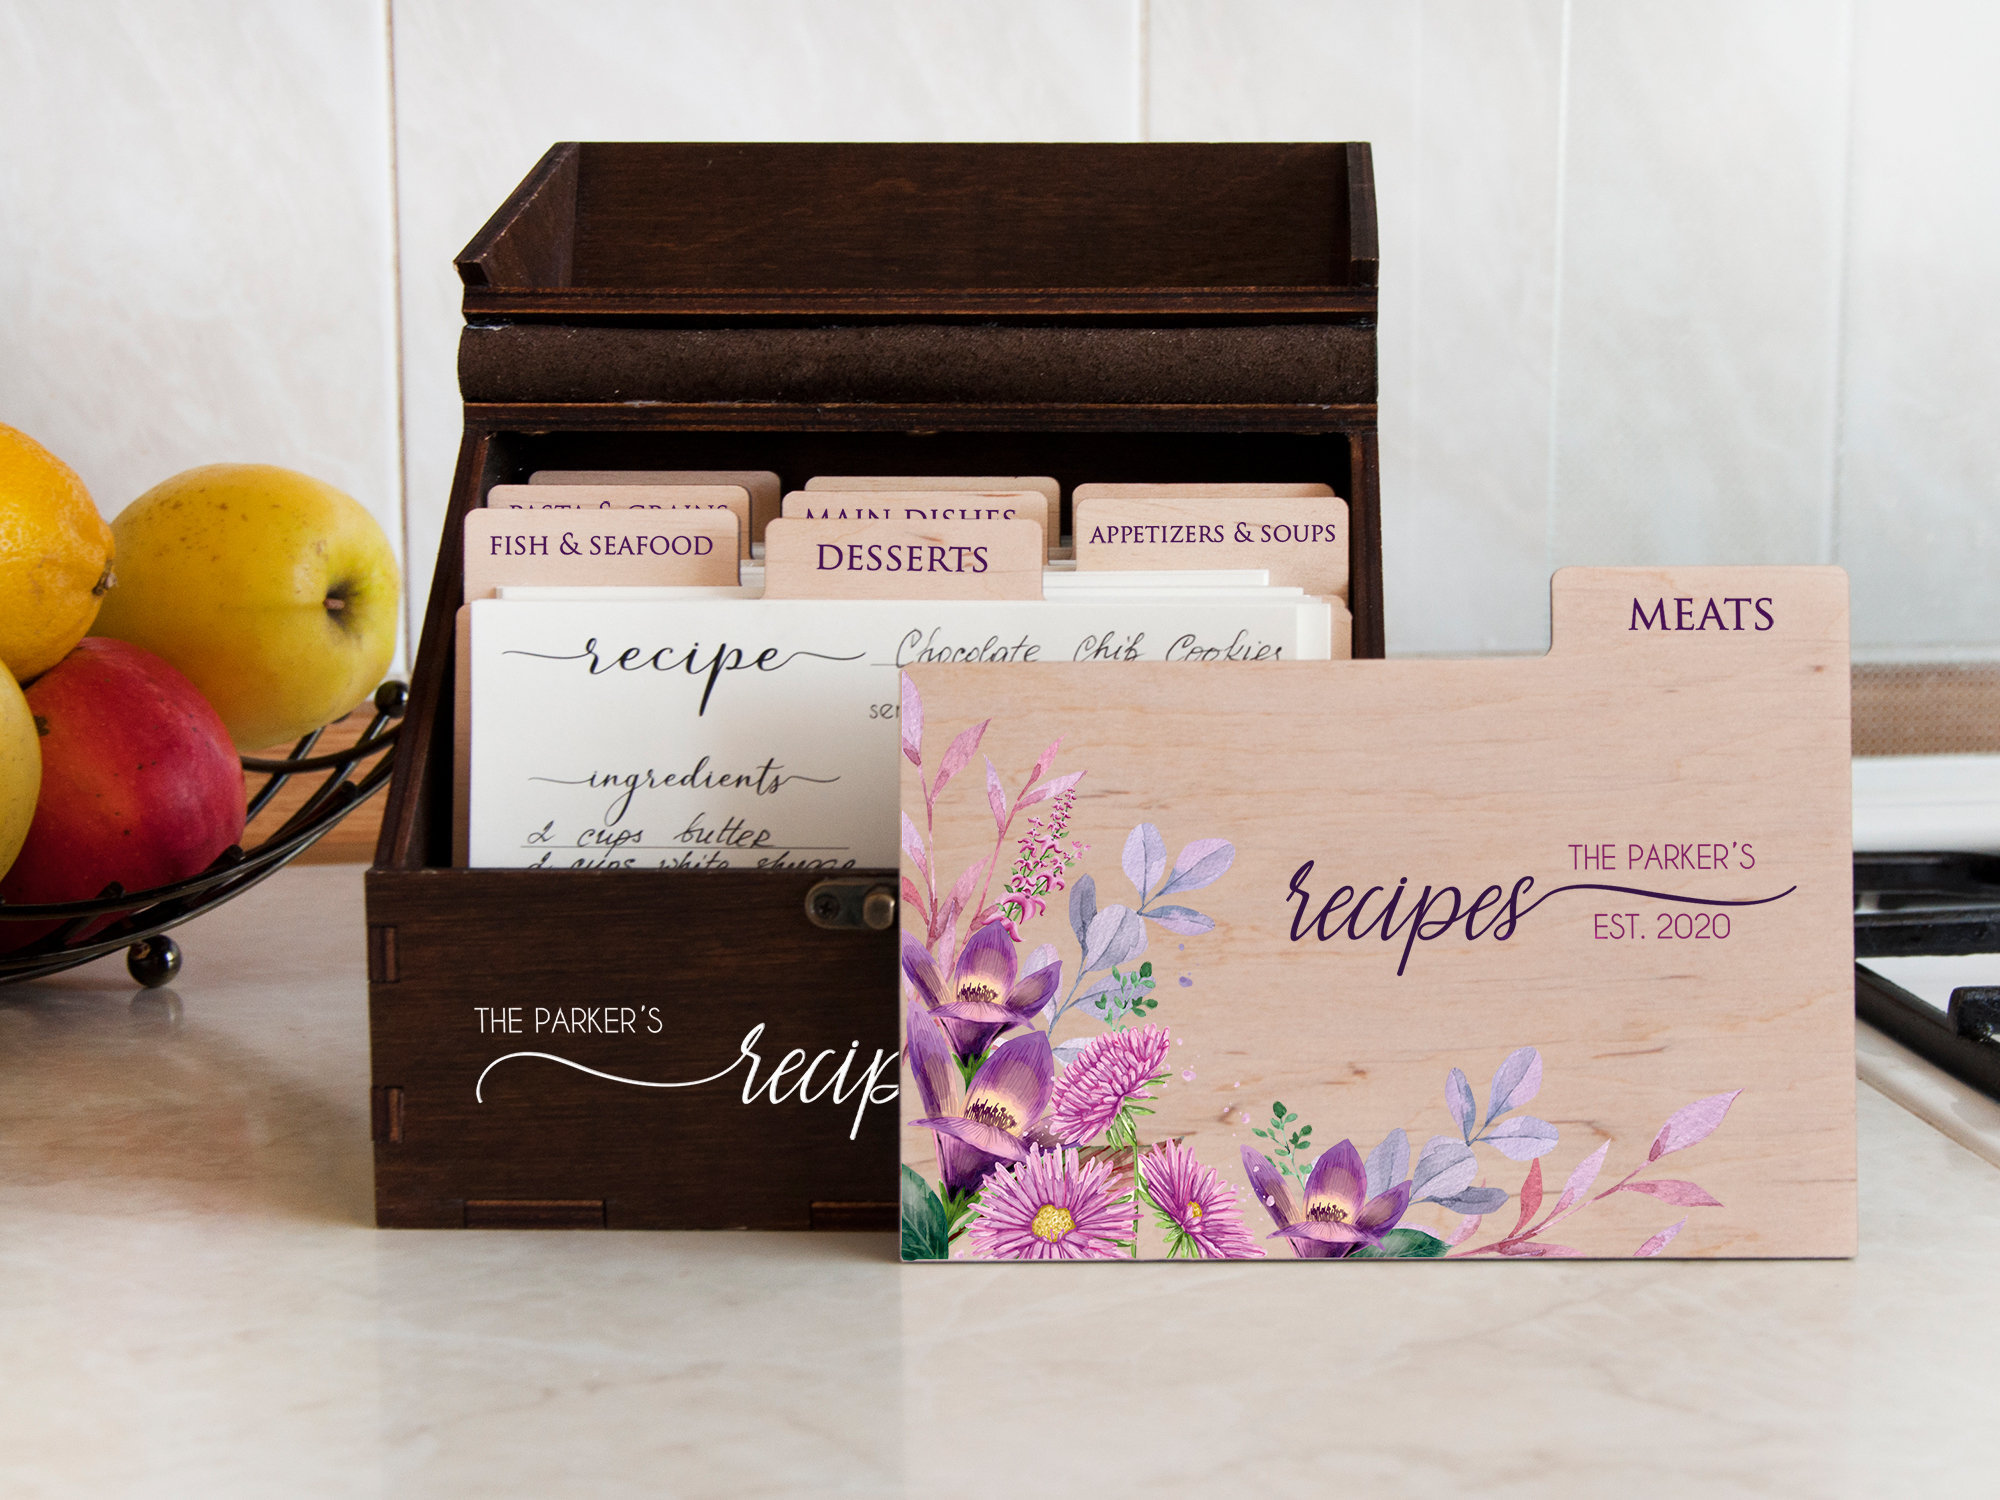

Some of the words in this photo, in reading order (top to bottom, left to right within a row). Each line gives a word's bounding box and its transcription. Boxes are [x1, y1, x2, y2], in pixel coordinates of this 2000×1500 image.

[490, 535, 548, 556] FISH
[560, 532, 582, 556] &
[590, 535, 714, 556] SEAFOOD
[1089, 525, 1225, 544] APPETIZERS
[1234, 522, 1254, 543] &
[1261, 524, 1336, 543] SOUPS
[816, 544, 988, 573] DESSERTS
[1628, 597, 1775, 632] MEATS
[896, 626, 1041, 668] Chocolate
[1165, 629, 1282, 661] Cookies
[578, 637, 800, 717] recipe
[580, 756, 800, 827] ingredients
[577, 828, 643, 857] cups
[1568, 844, 1616, 870] THE
[1629, 841, 1756, 870] PARKER'S
[1286, 859, 1540, 976] recipes
[1594, 913, 1645, 939] EST.
[1657, 913, 1731, 939] 2020
[474, 1007, 522, 1033] THE
[536, 1005, 663, 1034] PARKER'S
